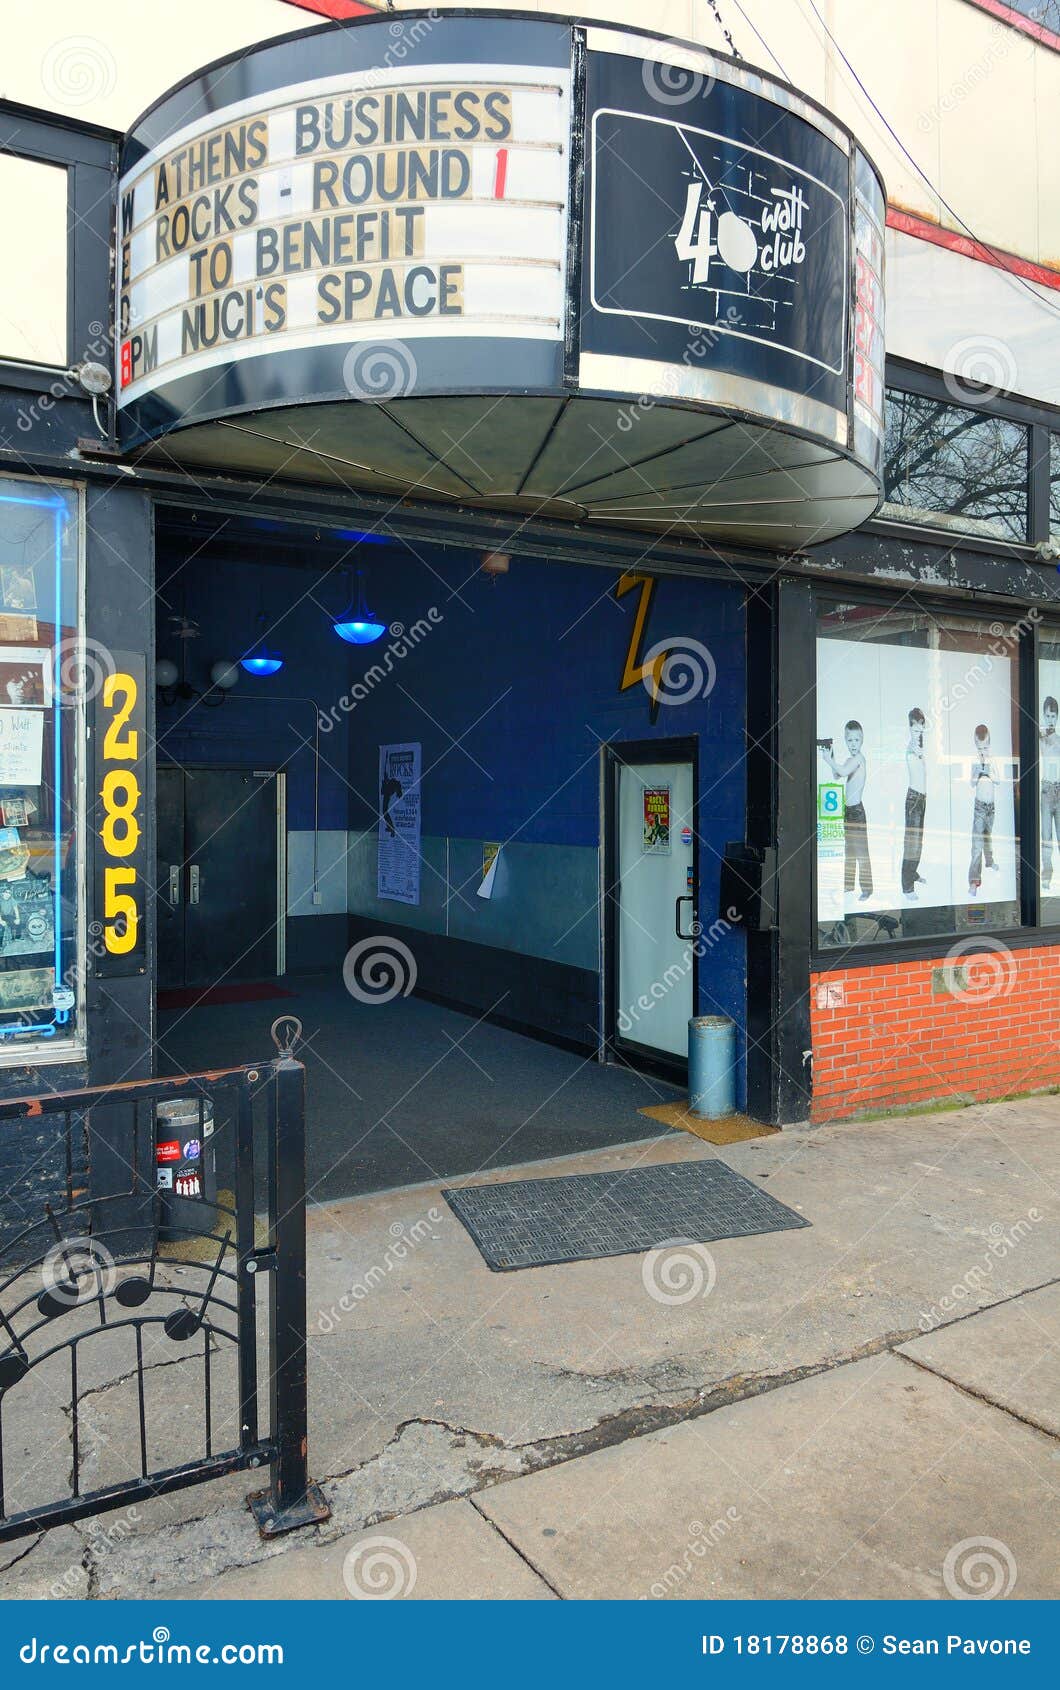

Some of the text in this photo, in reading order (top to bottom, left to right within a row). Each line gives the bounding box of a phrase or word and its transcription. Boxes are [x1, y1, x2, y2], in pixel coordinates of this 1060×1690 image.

[156, 91, 511, 210] ATHENS BUSINESS
[156, 148, 508, 262] ROCKS - ROUND 1
[674, 182, 758, 285] 40
[191, 207, 425, 297] TO BENEFIT
[760, 232, 806, 272] club
[182, 265, 463, 355] NUCI'S SPACE
[120, 324, 159, 389] 8PM
[99, 673, 142, 955] 285
[824, 790, 838, 812] 8
